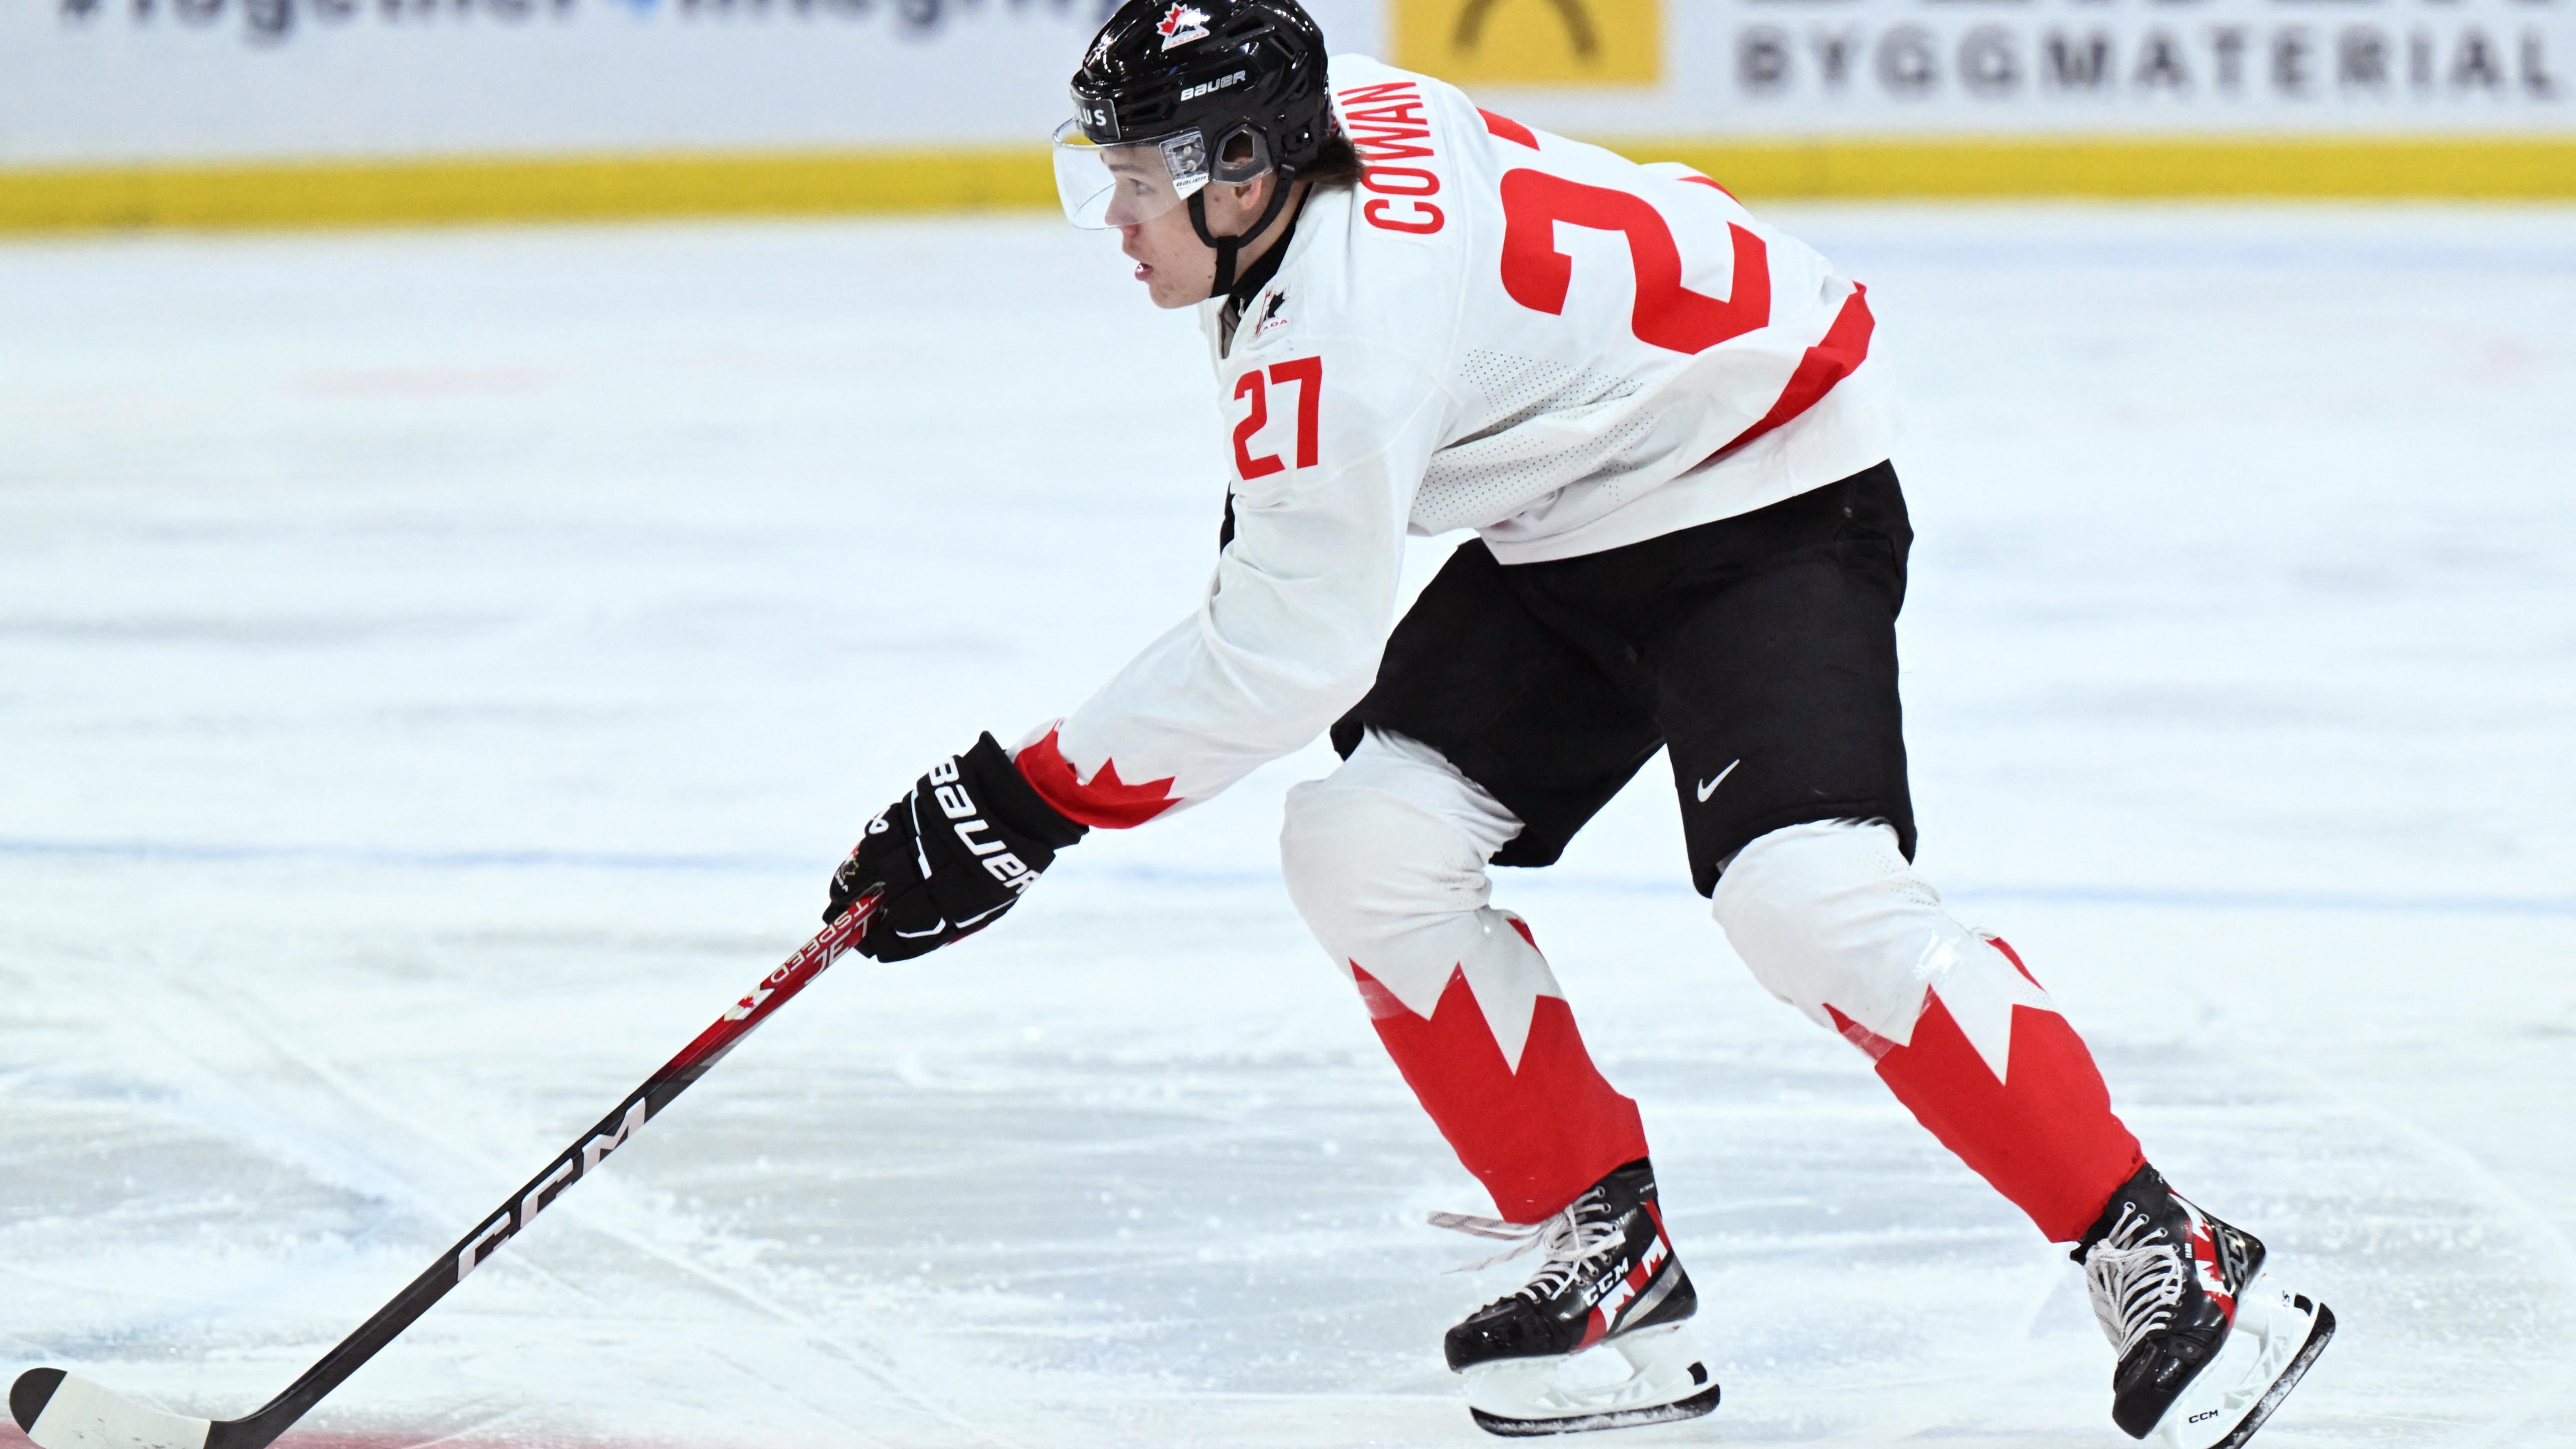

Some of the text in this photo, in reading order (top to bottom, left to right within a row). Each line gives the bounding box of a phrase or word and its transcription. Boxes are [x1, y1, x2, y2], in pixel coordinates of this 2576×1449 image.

[1734, 25, 2556, 100] BYGGMATERIAL
[1337, 81, 1445, 235] COWAN
[1233, 355, 1322, 481] 27
[458, 1097, 646, 1282] CCM
[1583, 1256, 1629, 1307] CCM
[2189, 1409, 2218, 1424] CCM
